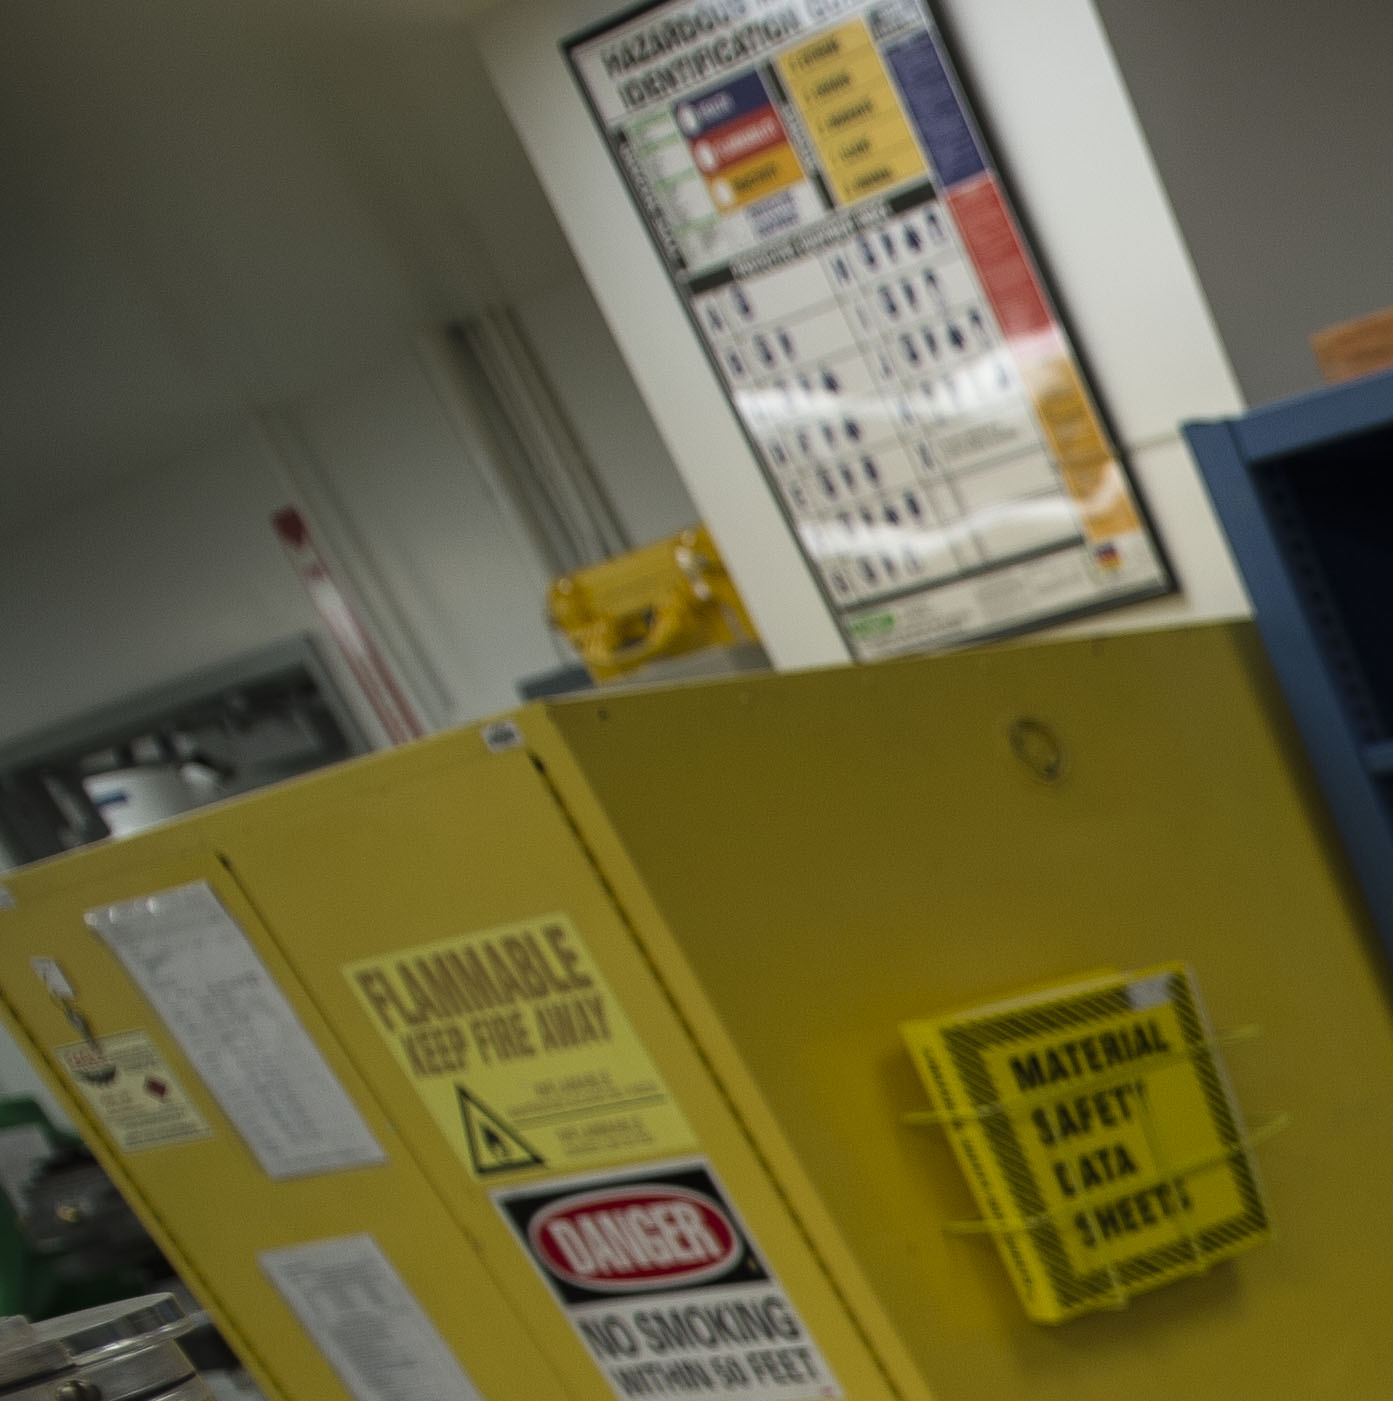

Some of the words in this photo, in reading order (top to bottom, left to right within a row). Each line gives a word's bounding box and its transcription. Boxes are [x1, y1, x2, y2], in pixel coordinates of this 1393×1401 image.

[356, 923, 595, 1033] FLAMMABLE
[403, 1025, 470, 1080] KEEP
[471, 1011, 536, 1067] FIRE
[535, 997, 613, 1051] AWAY
[1008, 1018, 1170, 1092] MATERIAL
[1031, 1081, 1146, 1148] SAFETY
[545, 1202, 727, 1277] DANGER
[576, 1318, 636, 1360] NO
[637, 1295, 803, 1352] SMOKING
[609, 1358, 713, 1399] WITHIN
[709, 1353, 745, 1387] 50
[746, 1346, 822, 1385] FEET
